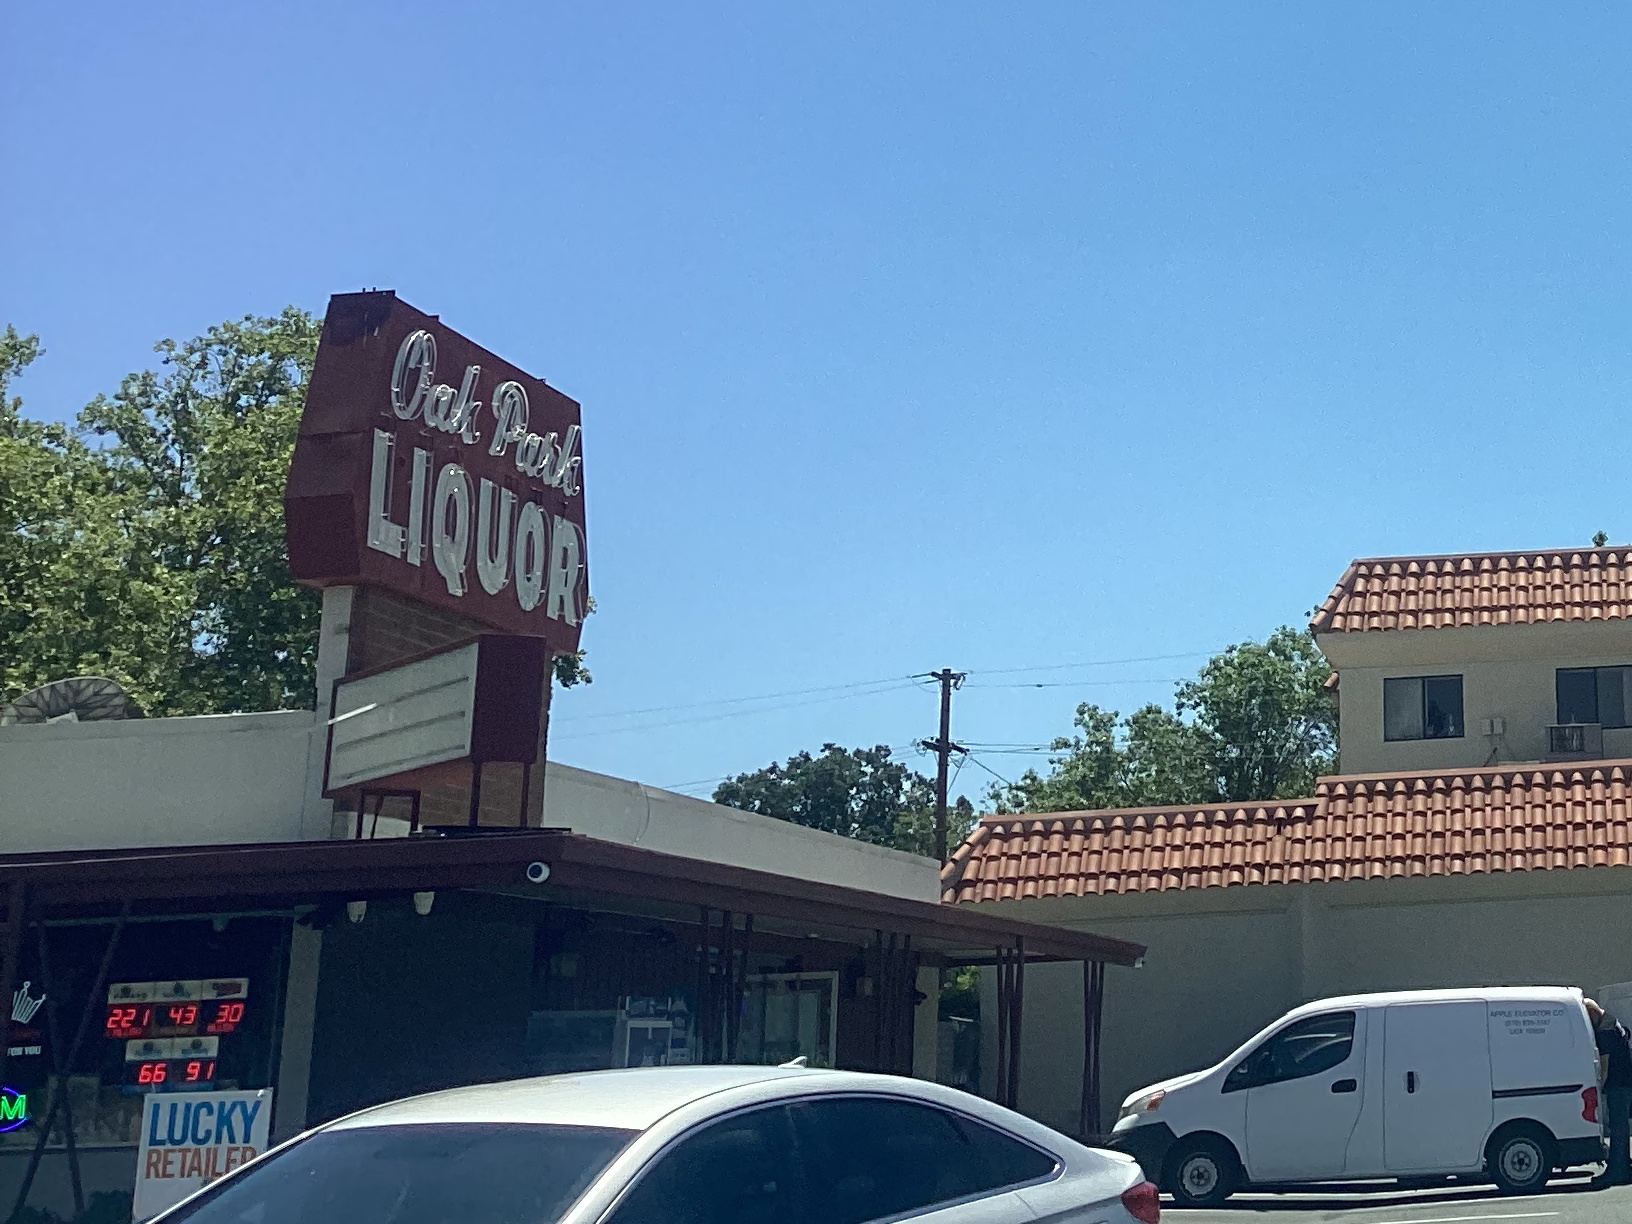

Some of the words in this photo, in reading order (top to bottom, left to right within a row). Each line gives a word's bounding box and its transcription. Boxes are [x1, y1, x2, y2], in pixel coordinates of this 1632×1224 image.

[391, 329, 483, 445] Oak
[488, 380, 582, 497] Park
[366, 427, 586, 628] LIQUOR
[107, 1008, 150, 1029] 221
[168, 1004, 198, 1025] 43
[215, 1002, 245, 1024] 30
[138, 1063, 167, 1085] 66
[185, 1061, 214, 1081] 91
[148, 1100, 262, 1147] LUCKY
